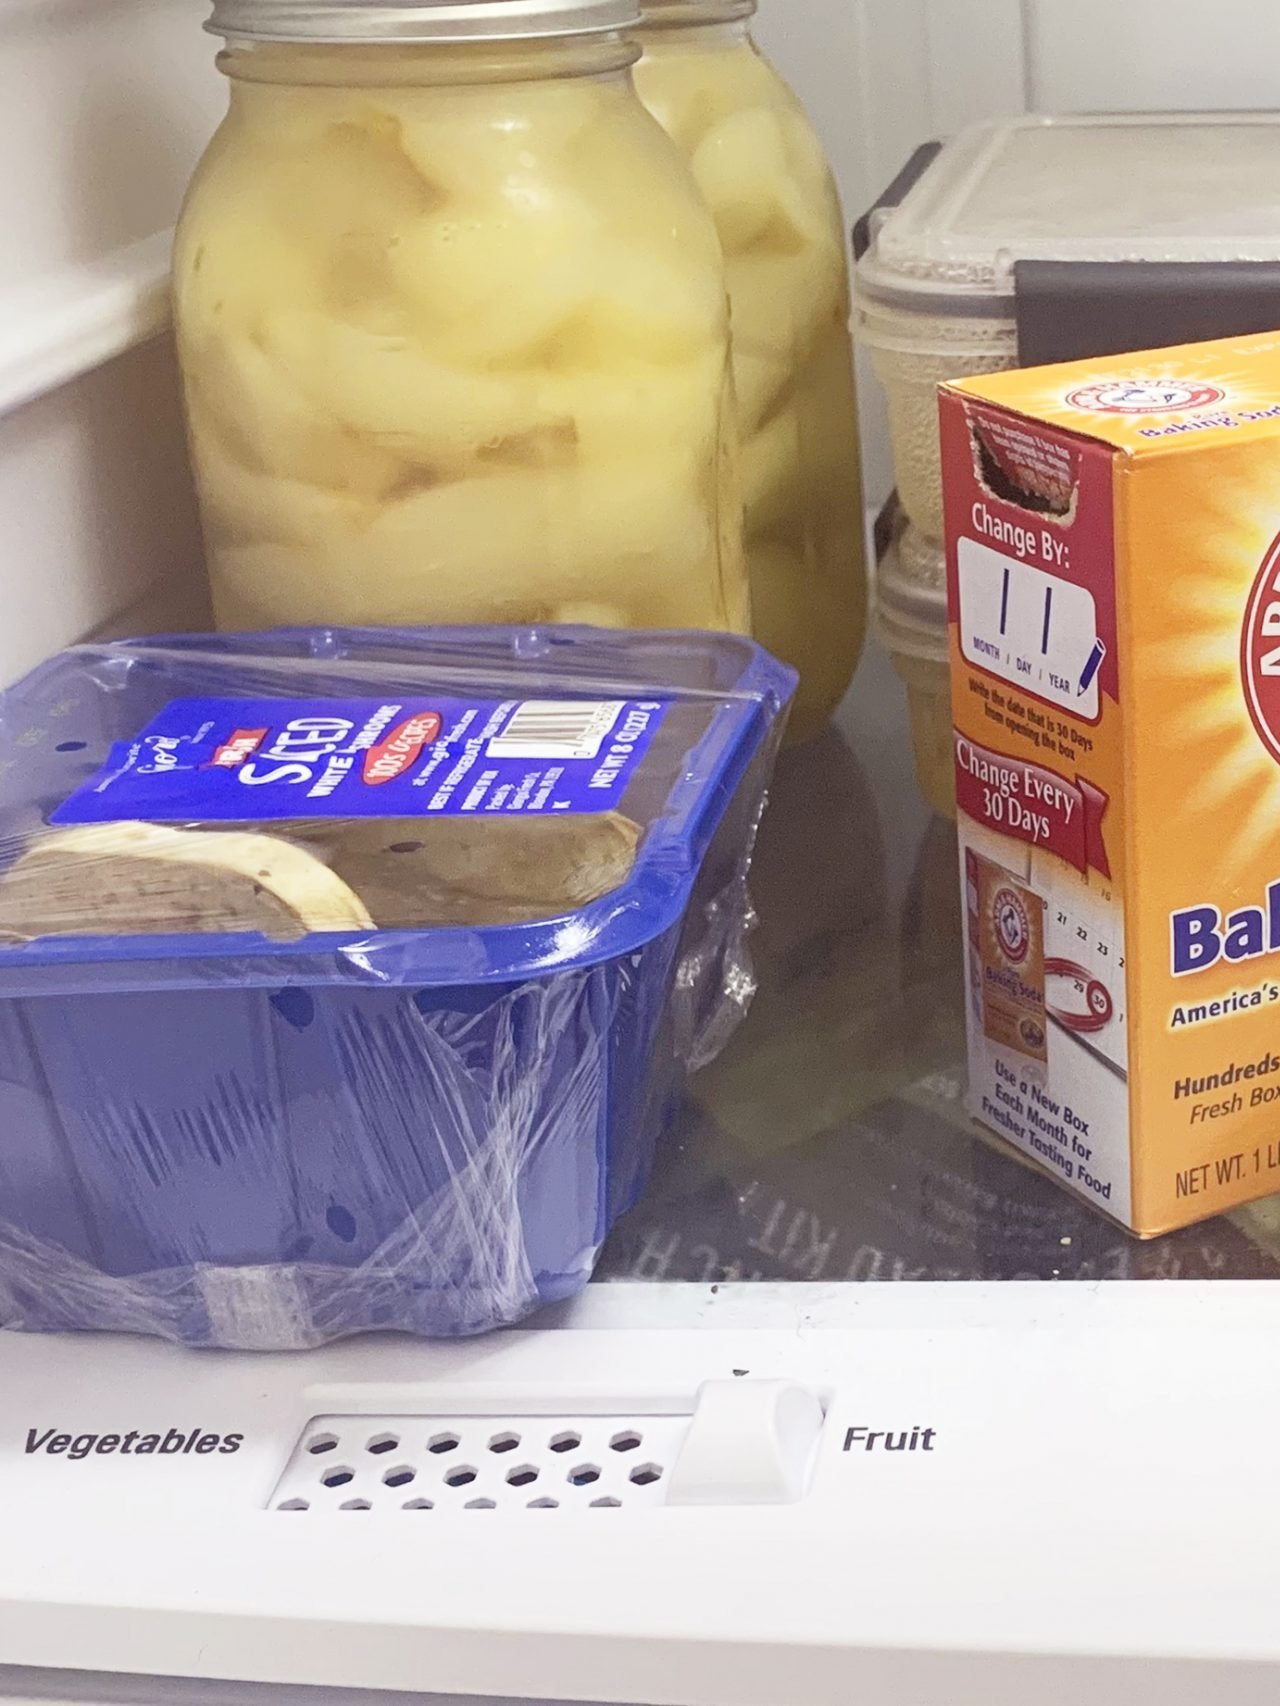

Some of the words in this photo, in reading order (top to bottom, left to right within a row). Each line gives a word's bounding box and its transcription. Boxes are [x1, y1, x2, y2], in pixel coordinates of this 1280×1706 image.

[972, 502, 1036, 557] Change
[973, 637, 1000, 660] MONTH
[1016, 657, 1032, 675] DAY
[1049, 672, 1070, 694] YEAR
[1005, 717, 1040, 748] opening
[1041, 731, 1056, 750] the
[1058, 740, 1075, 761] box
[1007, 695, 1025, 718] date
[1026, 706, 1045, 728] that
[1047, 717, 1055, 733] is
[1057, 722, 1069, 739] 30
[1070, 728, 1093, 752] Days
[306, 756, 352, 798] WHITE
[956, 739, 1019, 798] Change
[1024, 767, 1074, 825] Every
[983, 788, 1003, 821] 30
[1008, 797, 1050, 842] Days
[1057, 911, 1067, 925] 21
[1076, 926, 1088, 942] 22
[1097, 942, 1109, 956] 23
[1074, 979, 1084, 994] 29
[1171, 982, 1280, 1027] America's
[995, 1058, 1017, 1087] Use
[1019, 1081, 1028, 1096] a
[1031, 1084, 1061, 1116] New
[1063, 1106, 1090, 1137] Box
[1174, 1052, 1280, 1100] Hundreds
[995, 1083, 1024, 1115] Each
[1027, 1106, 1069, 1147] Month
[1071, 1136, 1092, 1162] for
[1190, 1092, 1242, 1125] Fresh
[982, 1095, 1027, 1139] Fresher
[1028, 1129, 1074, 1178] Tasting
[1077, 1164, 1112, 1200] Food
[1175, 1163, 1211, 1199] NET
[1216, 1153, 1247, 1186] WT.
[1252, 1148, 1261, 1174] 1
[22, 1425, 245, 1461] Vegetables
[842, 1425, 937, 1454] Fruit
